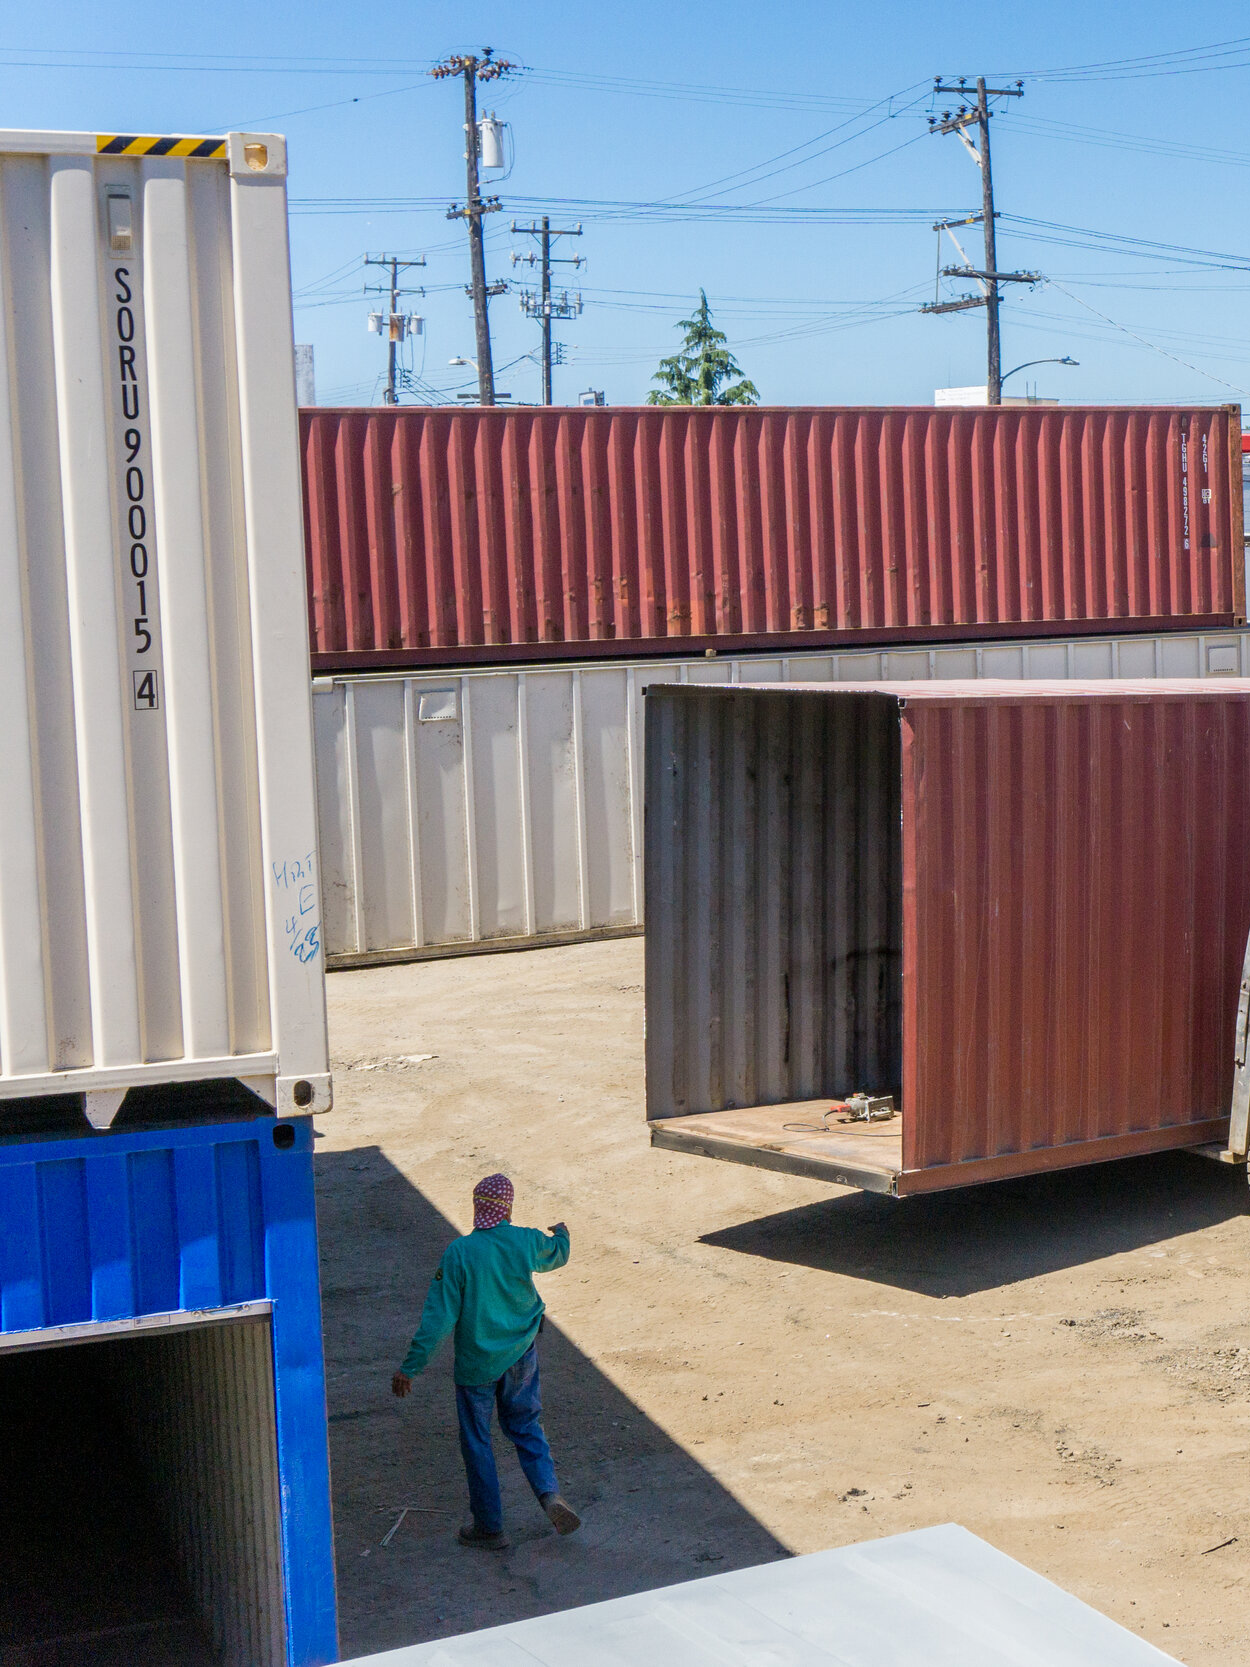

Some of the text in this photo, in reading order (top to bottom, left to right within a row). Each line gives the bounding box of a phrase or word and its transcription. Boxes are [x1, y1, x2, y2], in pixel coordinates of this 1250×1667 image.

[115, 267, 157, 708] SORU 900015 4
